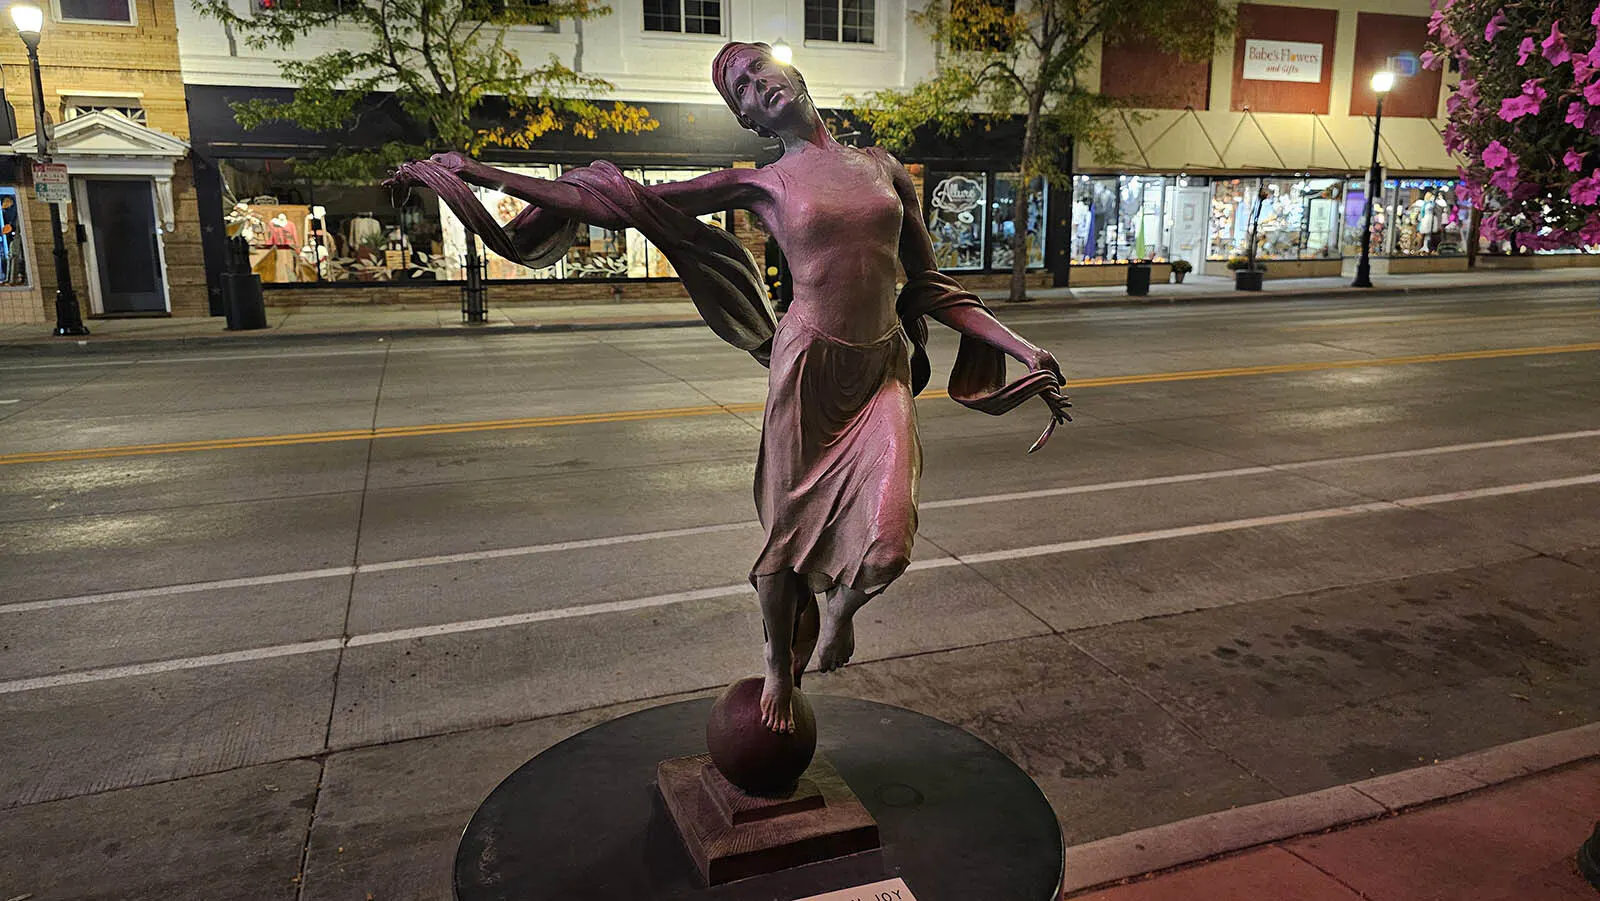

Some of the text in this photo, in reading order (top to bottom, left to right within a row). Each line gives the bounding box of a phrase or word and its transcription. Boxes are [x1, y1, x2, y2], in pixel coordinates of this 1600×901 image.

[1249, 46, 1318, 64] Babe's Flowers
[1266, 65, 1280, 73] and
[937, 181, 976, 202] Allure
